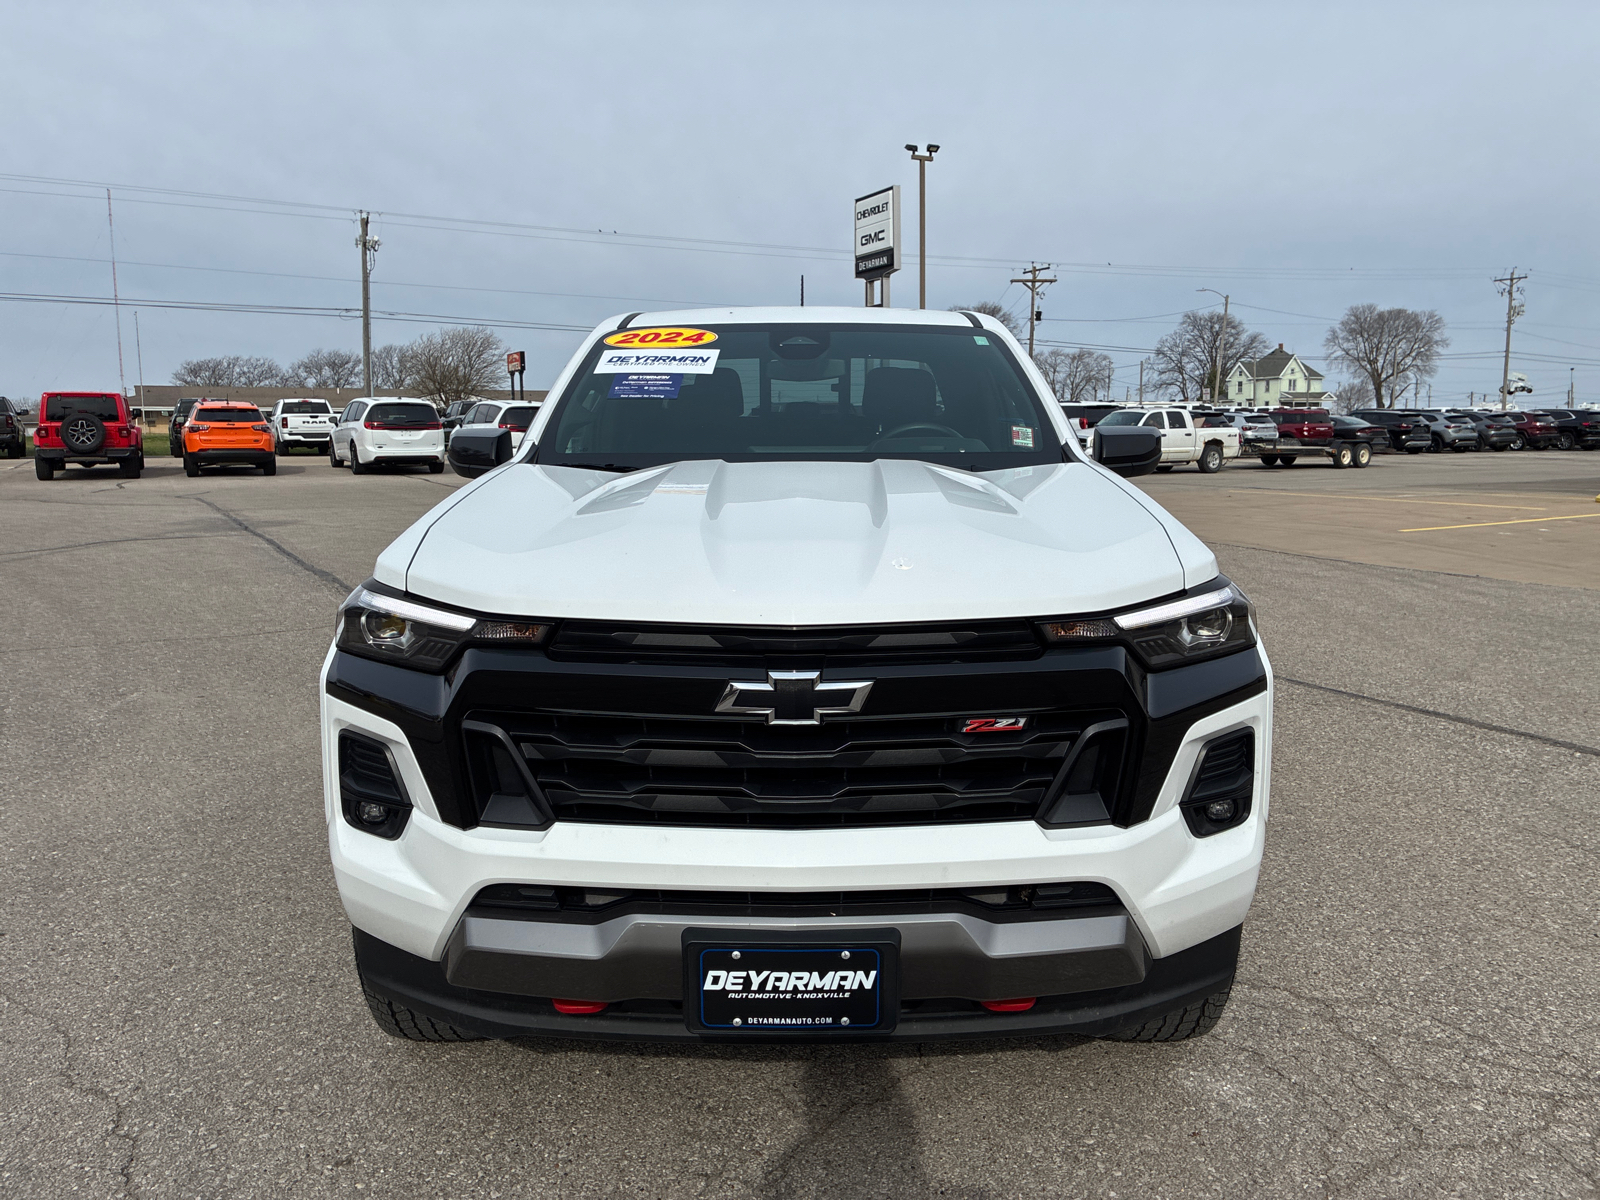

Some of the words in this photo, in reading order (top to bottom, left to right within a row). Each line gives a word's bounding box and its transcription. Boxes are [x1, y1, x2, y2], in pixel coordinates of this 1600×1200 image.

[857, 201, 889, 220] CHEVROLET
[861, 229, 885, 246] GMC
[859, 256, 888, 270] DEYARMAN
[613, 332, 707, 345] 2024
[961, 717, 1027, 732] Z71
[703, 970, 877, 990] DEYARMAN
[747, 1017, 833, 1025] DEYARMANAUTO.COM
